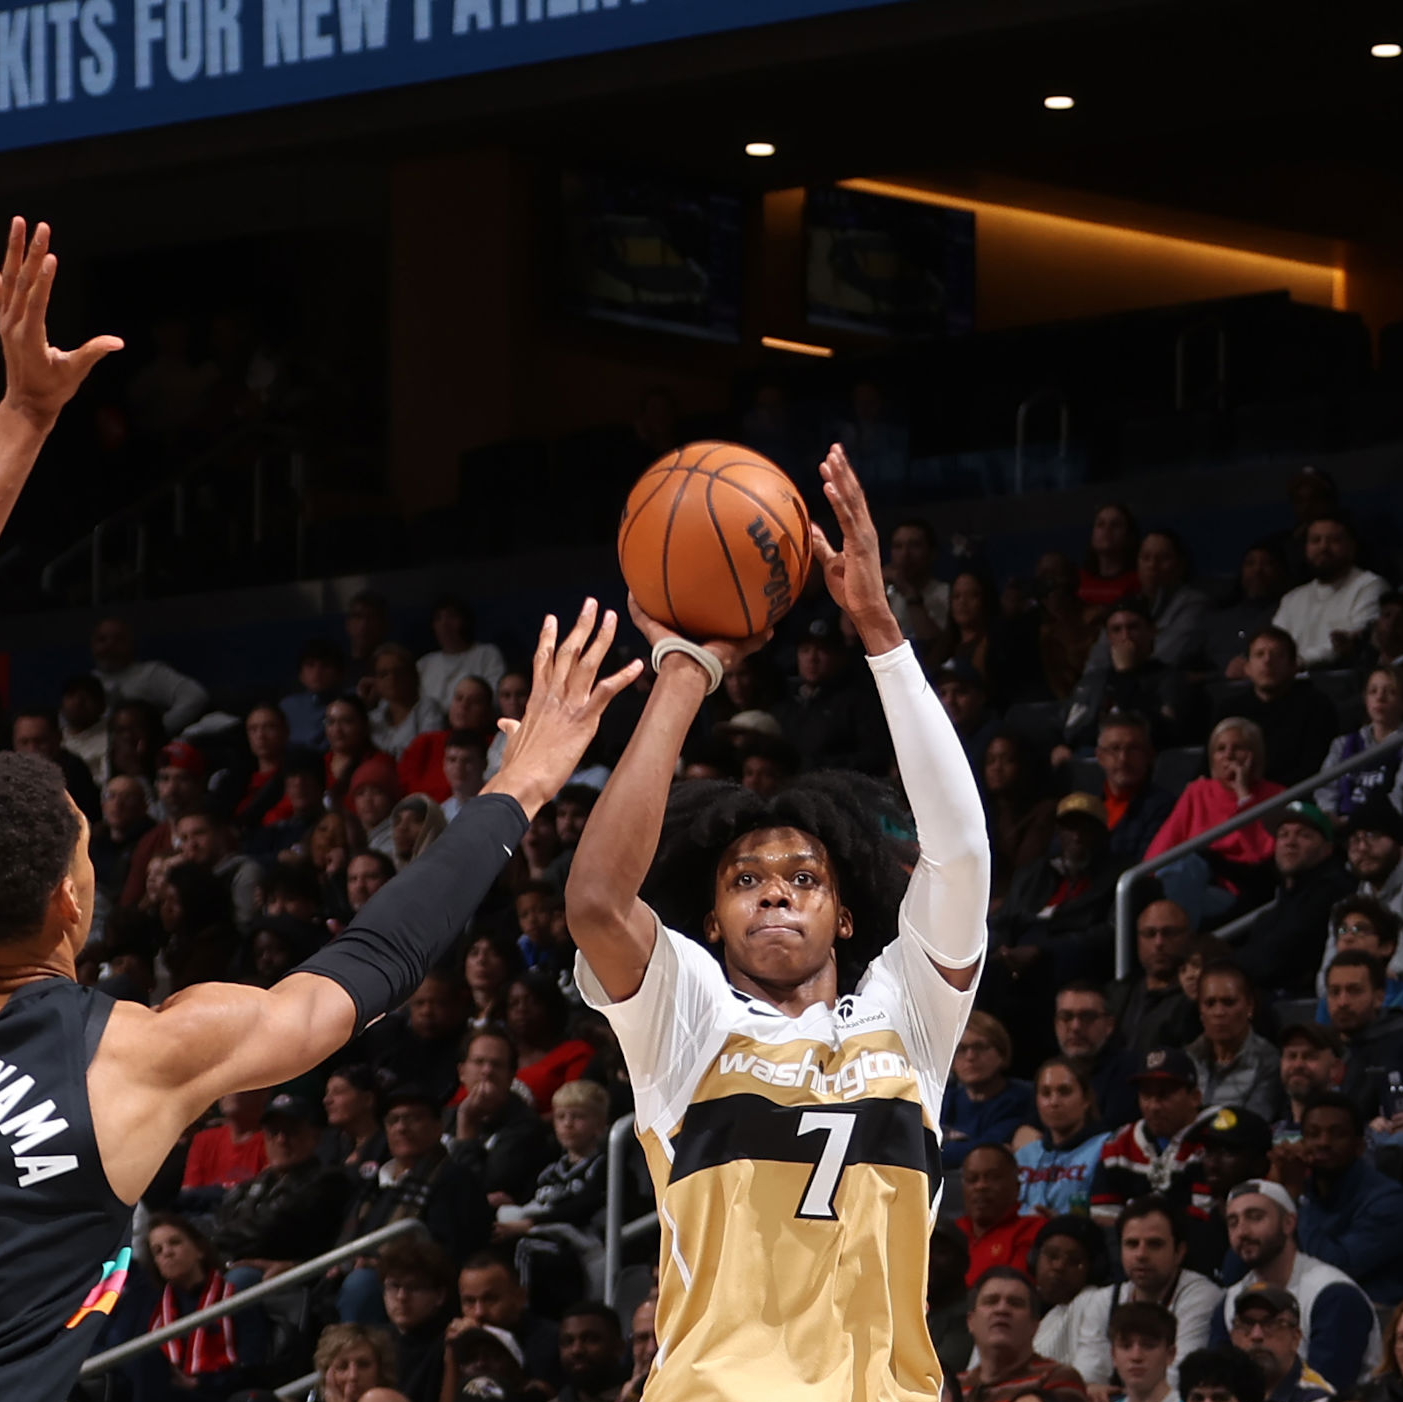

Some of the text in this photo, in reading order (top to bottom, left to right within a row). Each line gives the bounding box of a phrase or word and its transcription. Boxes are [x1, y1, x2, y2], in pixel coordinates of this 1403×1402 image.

[135, 0, 241, 88] FOR
[719, 1048, 911, 1100] washington
[795, 1110, 858, 1220] 7
